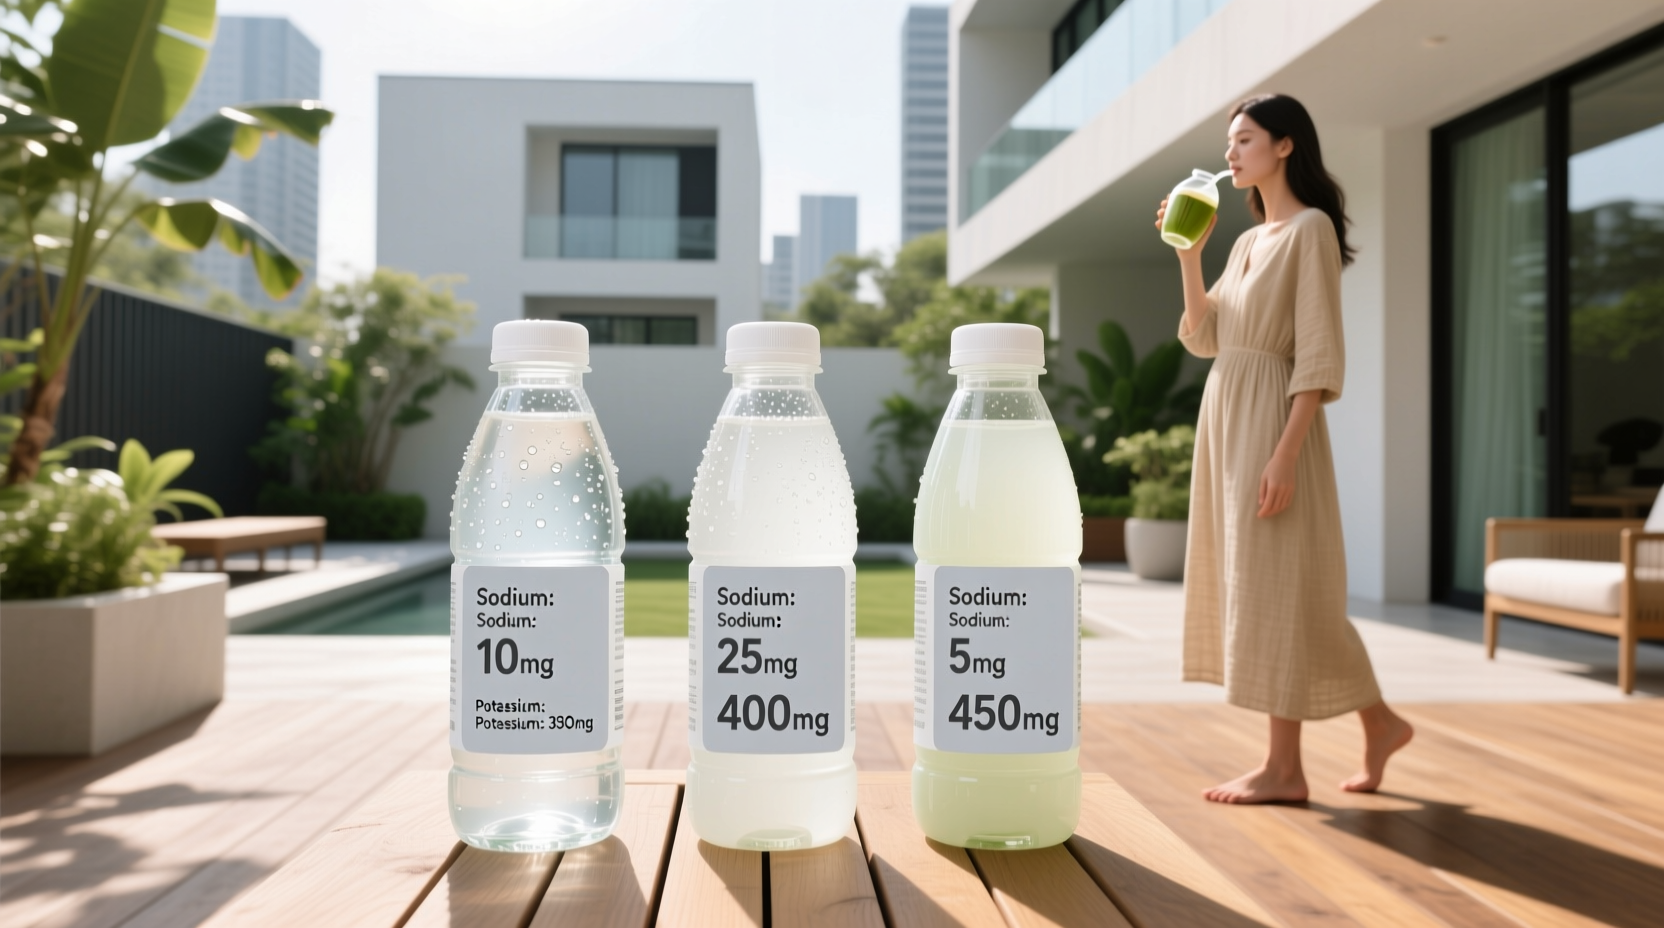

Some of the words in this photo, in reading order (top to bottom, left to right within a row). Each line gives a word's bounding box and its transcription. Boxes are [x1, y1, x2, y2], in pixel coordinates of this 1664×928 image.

[476, 587, 554, 606] Sodium:
[717, 587, 795, 606] Sodium:
[949, 587, 1027, 606] Sodium:
[717, 612, 782, 628] Sodium:
[949, 612, 1010, 628] Sodium:
[476, 638, 554, 679] 10mg
[717, 638, 798, 679] 25mg
[949, 638, 1006, 679] 5mg
[717, 694, 830, 737] 400mg
[948, 694, 1060, 737] 450mg
